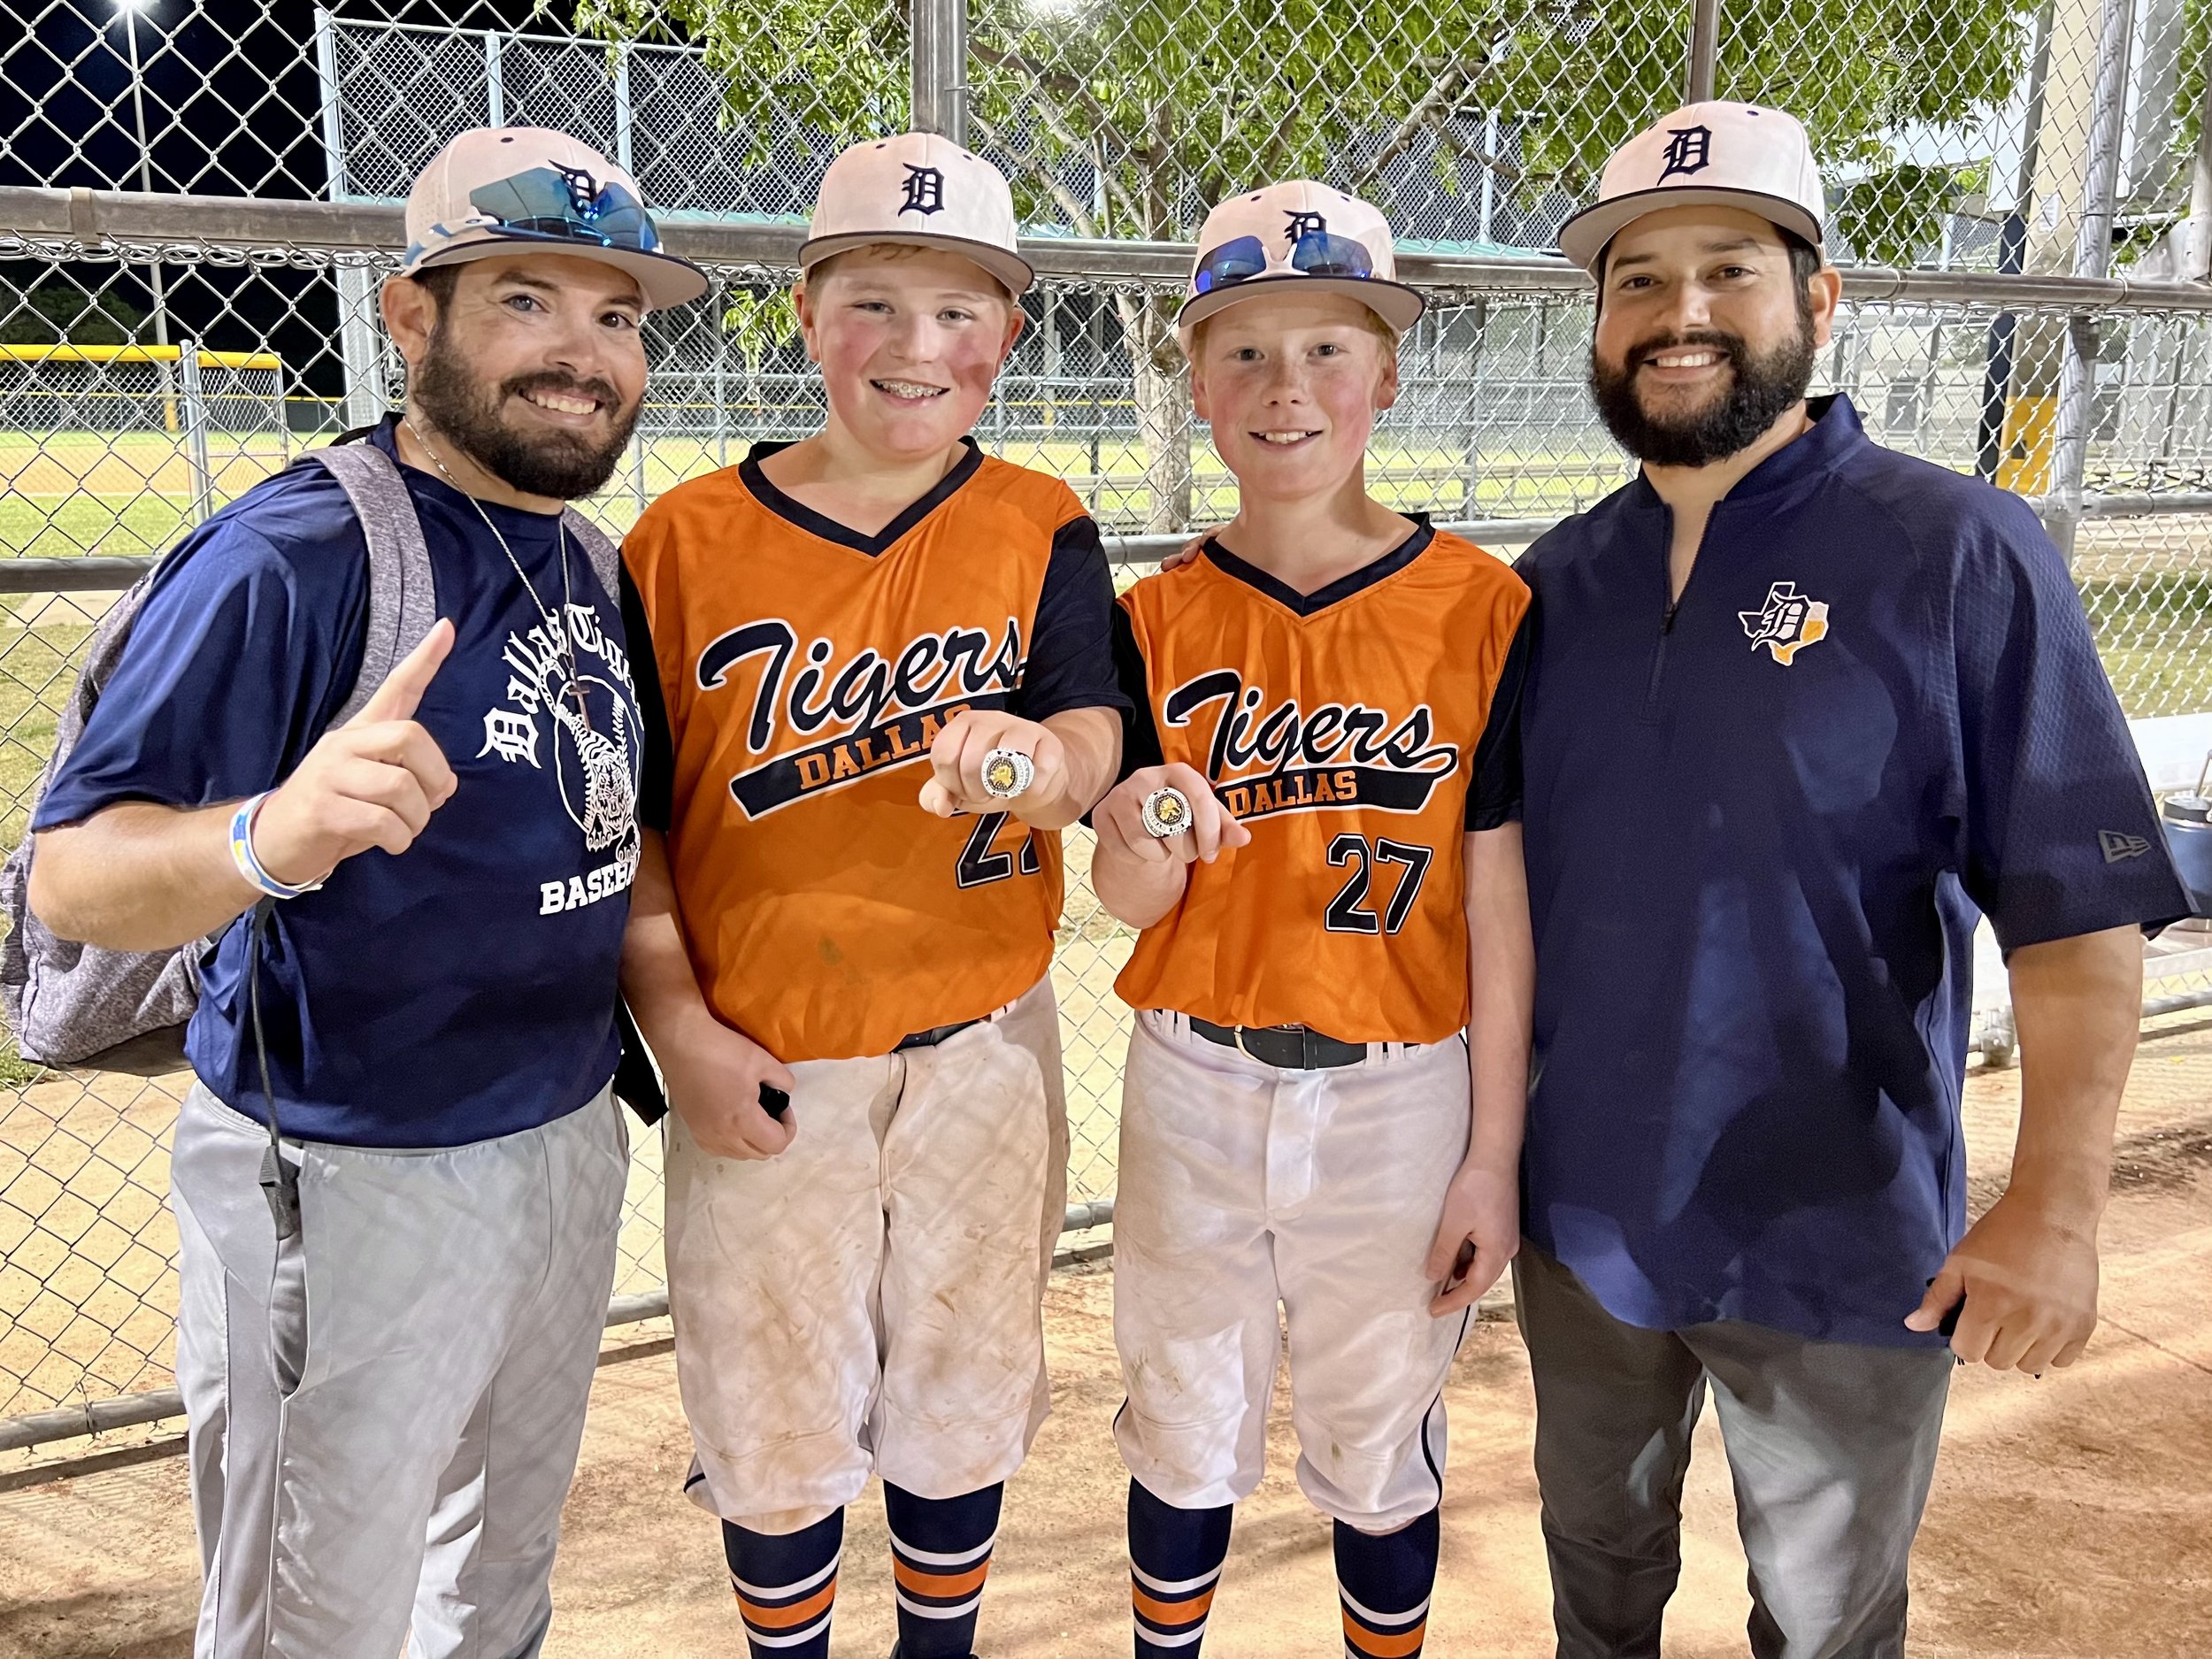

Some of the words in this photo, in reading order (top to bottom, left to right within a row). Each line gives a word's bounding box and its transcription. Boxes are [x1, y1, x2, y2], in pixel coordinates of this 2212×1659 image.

[1656, 125, 1712, 187] D
[897, 162, 945, 218] D
[1751, 591, 1811, 652] D
[475, 608, 568, 769] Dallas
[564, 603, 645, 732] Tige
[696, 616, 1028, 755] Tigers
[1163, 667, 1460, 786] Tigers
[1225, 770, 1358, 818] DALLAS
[539, 854, 641, 916] BASEBA
[1325, 833, 1433, 935] 27
